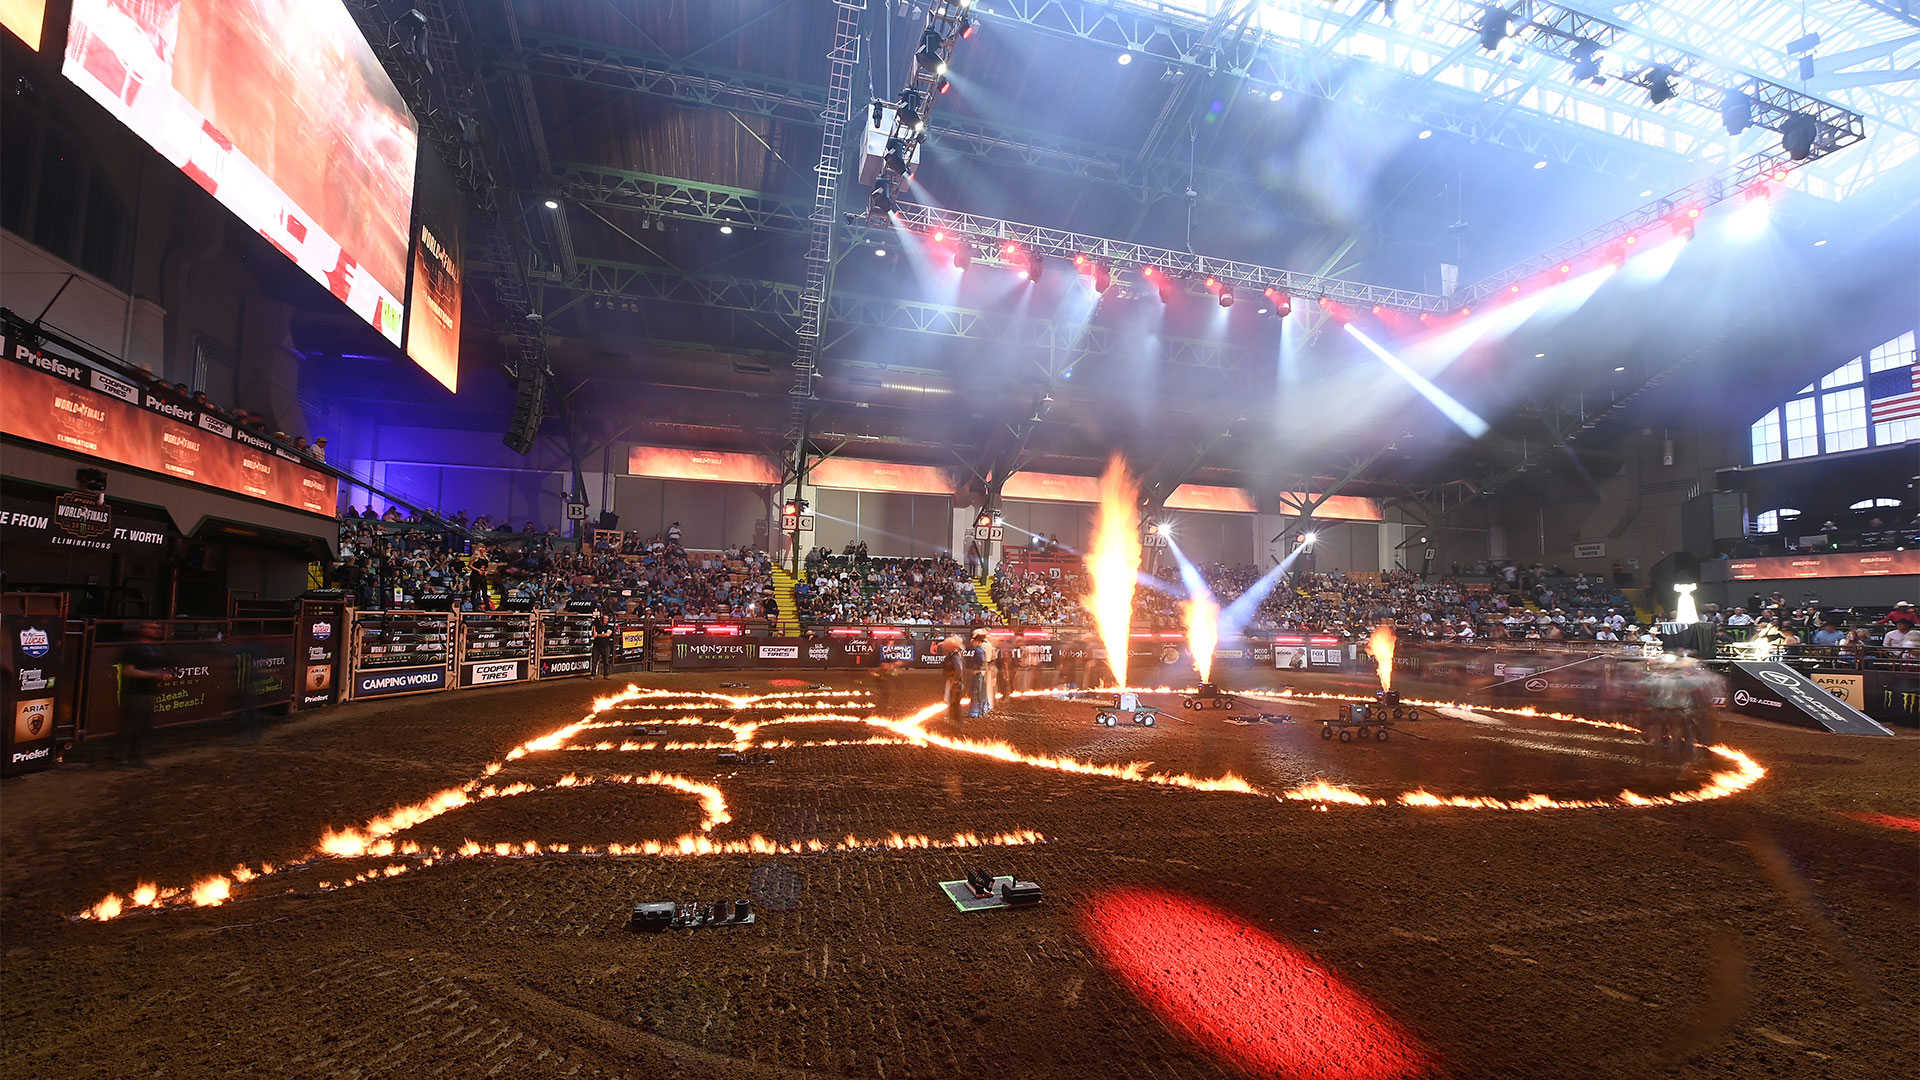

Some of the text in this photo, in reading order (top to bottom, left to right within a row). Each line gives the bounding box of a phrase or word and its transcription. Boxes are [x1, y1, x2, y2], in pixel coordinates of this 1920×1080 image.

[421, 225, 441, 259] WORLD
[16, 344, 82, 381] Priefert
[98, 376, 132, 393] COOPER
[104, 383, 127, 397] TIRES
[54, 396, 78, 413] WORLD
[83, 403, 105, 422] FINALS
[145, 394, 194, 421] Priefert
[58, 504, 109, 523] WORLD FINALS
[571, 506, 583, 516] B
[11, 513, 49, 529] FROM
[801, 518, 811, 527] C
[113, 527, 164, 544] FT. WORTH
[979, 529, 1002, 538] C D
[51, 536, 111, 550] ELIMINATIONS
[24, 636, 46, 645] LUCAS
[690, 644, 744, 654] MONSTER
[844, 645, 874, 653] ULTRA
[881, 645, 912, 653] CAMPING
[882, 652, 912, 660] WORLD
[476, 664, 514, 674] COOPER
[550, 660, 590, 673] MODO CASINO
[362, 673, 439, 690] CAMPING WORLD
[481, 671, 509, 681] TIRES
[23, 703, 50, 714] ARIAT
[12, 748, 50, 764] Priefert
